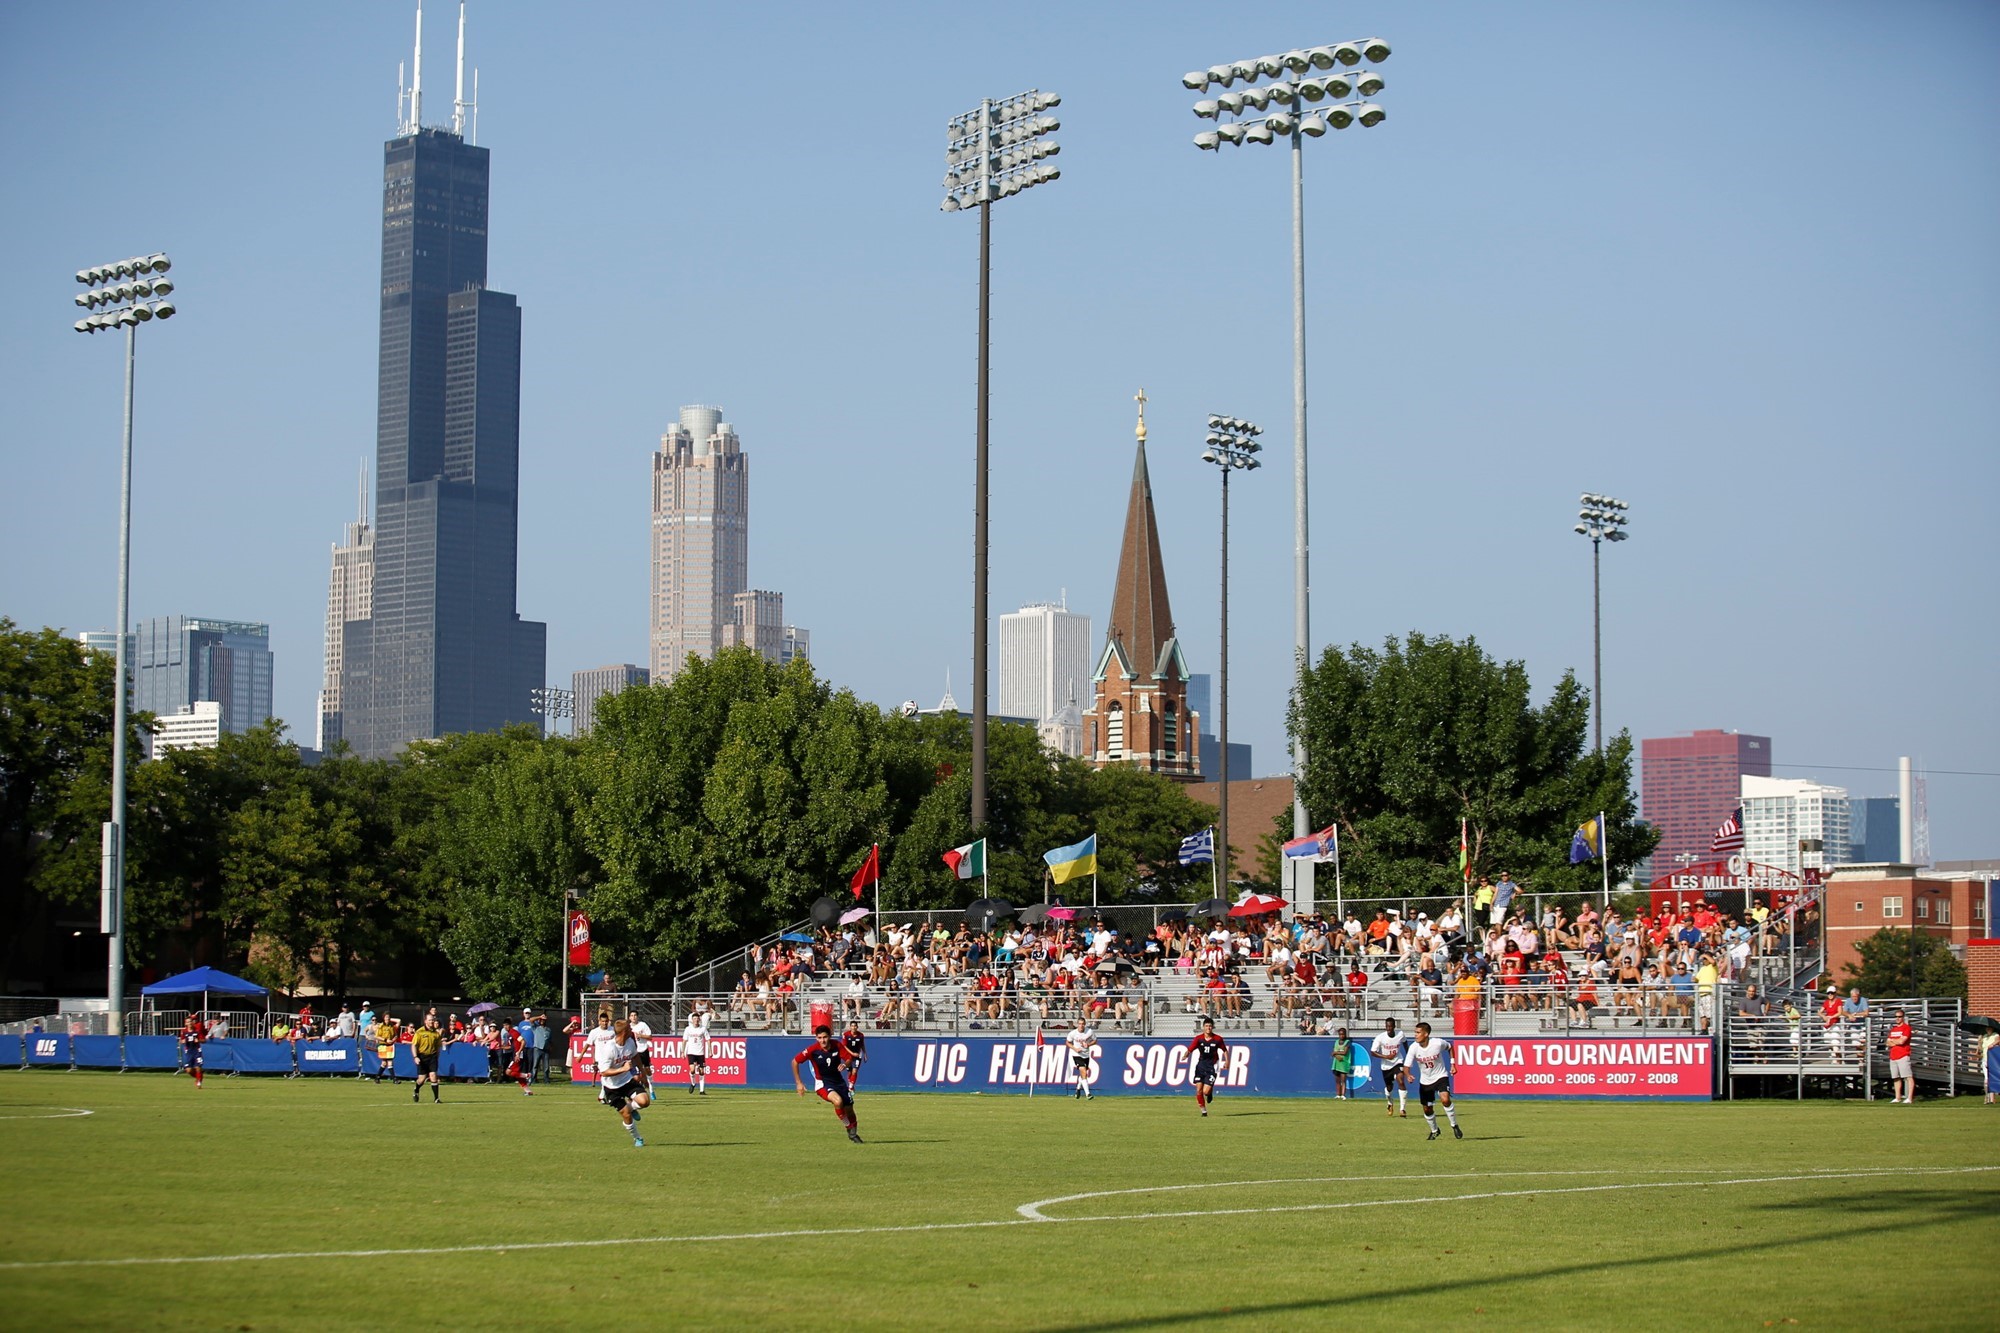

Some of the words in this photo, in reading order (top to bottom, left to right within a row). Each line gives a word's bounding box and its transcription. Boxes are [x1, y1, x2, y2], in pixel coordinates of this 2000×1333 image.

[1671, 875, 1698, 888] LES
[1760, 877, 1799, 890] FIELD
[572, 931, 588, 944] UIC
[36, 1039, 57, 1052] UIC
[1457, 1044, 1525, 1066] NCAA
[1532, 1043, 1709, 1065] TOURNAMENT
[826, 1057, 832, 1067] 9
[914, 1043, 968, 1083] UIC
[662, 1065, 681, 1074] 2007
[718, 1066, 739, 1075] 2013
[1485, 1073, 1514, 1085] 1999
[1524, 1073, 1555, 1085] 2000
[1565, 1073, 1596, 1085] 2006
[1606, 1073, 1637, 1085] 2007
[1647, 1073, 1679, 1085] 2008
